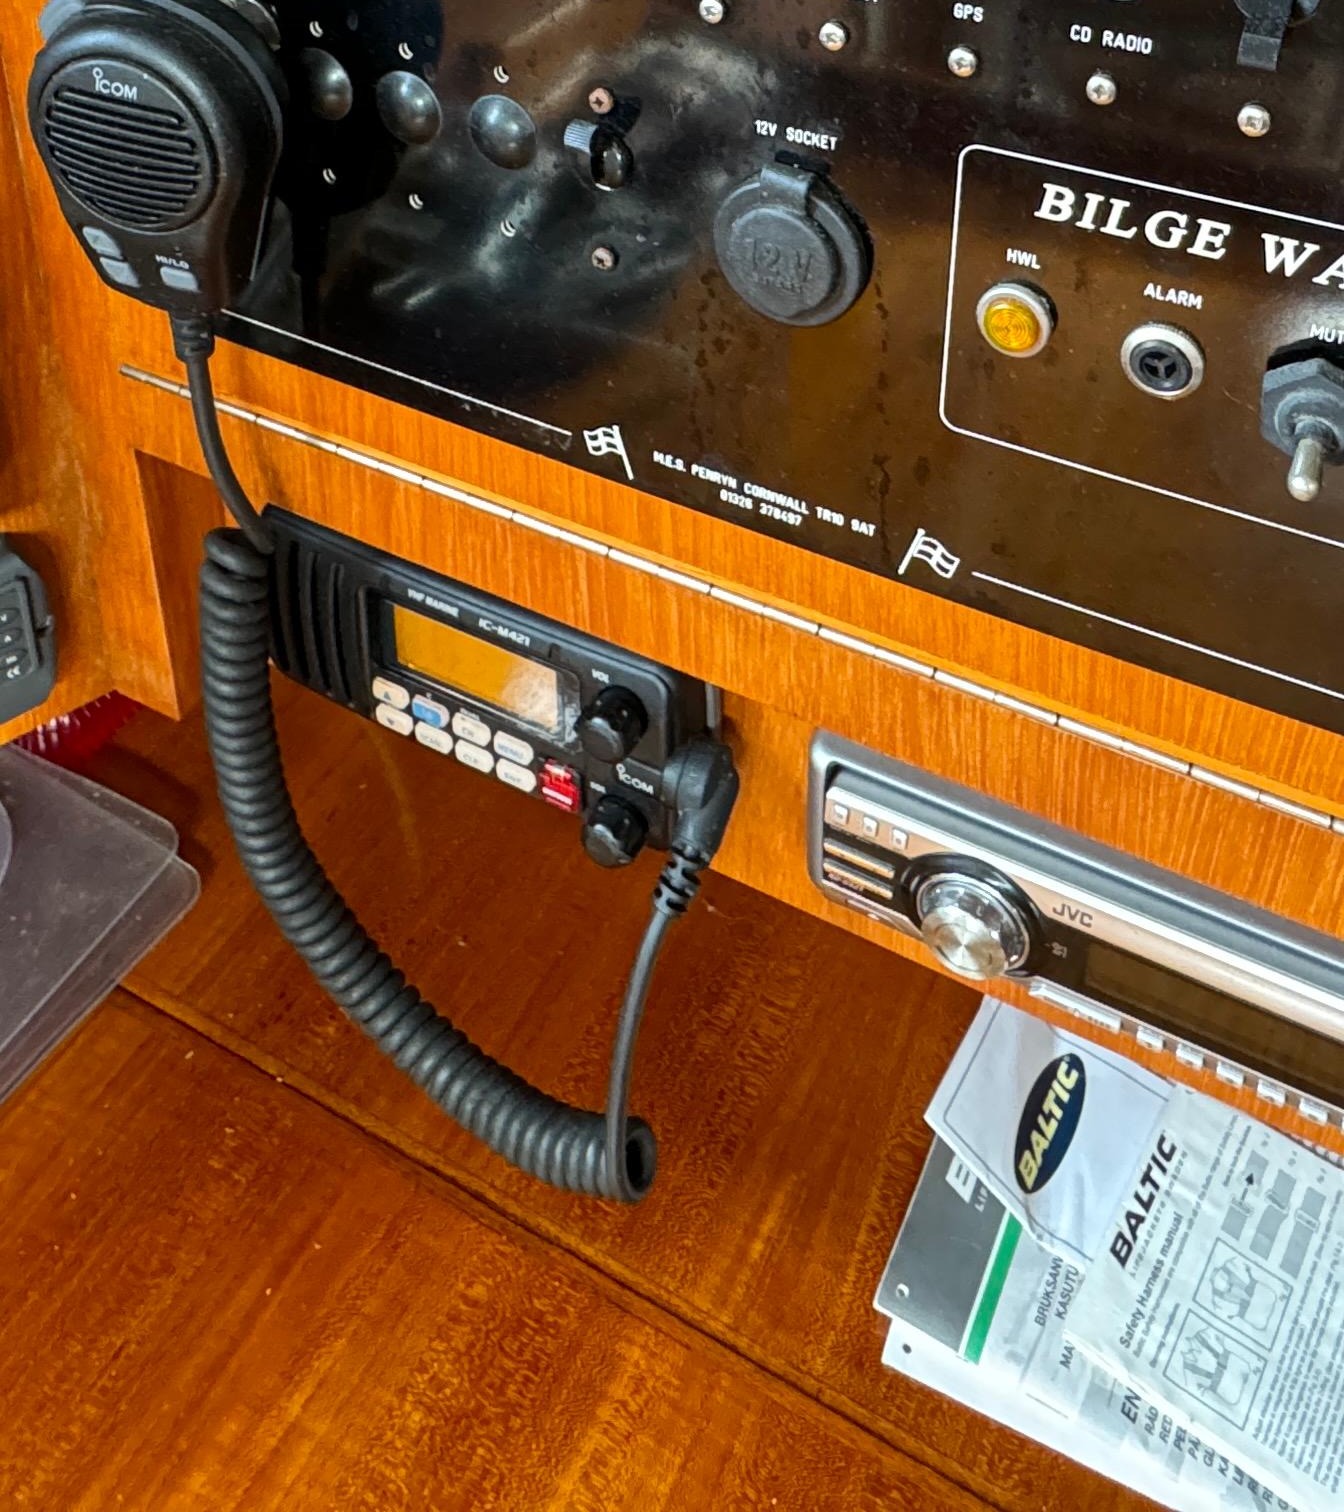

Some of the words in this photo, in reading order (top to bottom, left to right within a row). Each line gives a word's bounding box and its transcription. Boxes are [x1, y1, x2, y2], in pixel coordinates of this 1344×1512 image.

[953, 2, 984, 23] GPS
[1069, 24, 1092, 44] CD
[1102, 29, 1153, 55] RADIO
[754, 119, 779, 138] 12V
[786, 124, 838, 152] SOCKET
[1034, 182, 1233, 261] BILGE
[1006, 247, 1041, 270] HWL
[1143, 282, 1203, 310] ALARM
[743, 481, 809, 516] CORNWALL
[591, 668, 610, 684] VOL
[1051, 902, 1094, 929] JVC
[1016, 1060, 1080, 1190] BALTIC
[1108, 1133, 1177, 1269] BALTIC
[1118, 1306, 1145, 1349] Safety
[1136, 1257, 1165, 1307] Harness
[1159, 1210, 1183, 1258] manual
